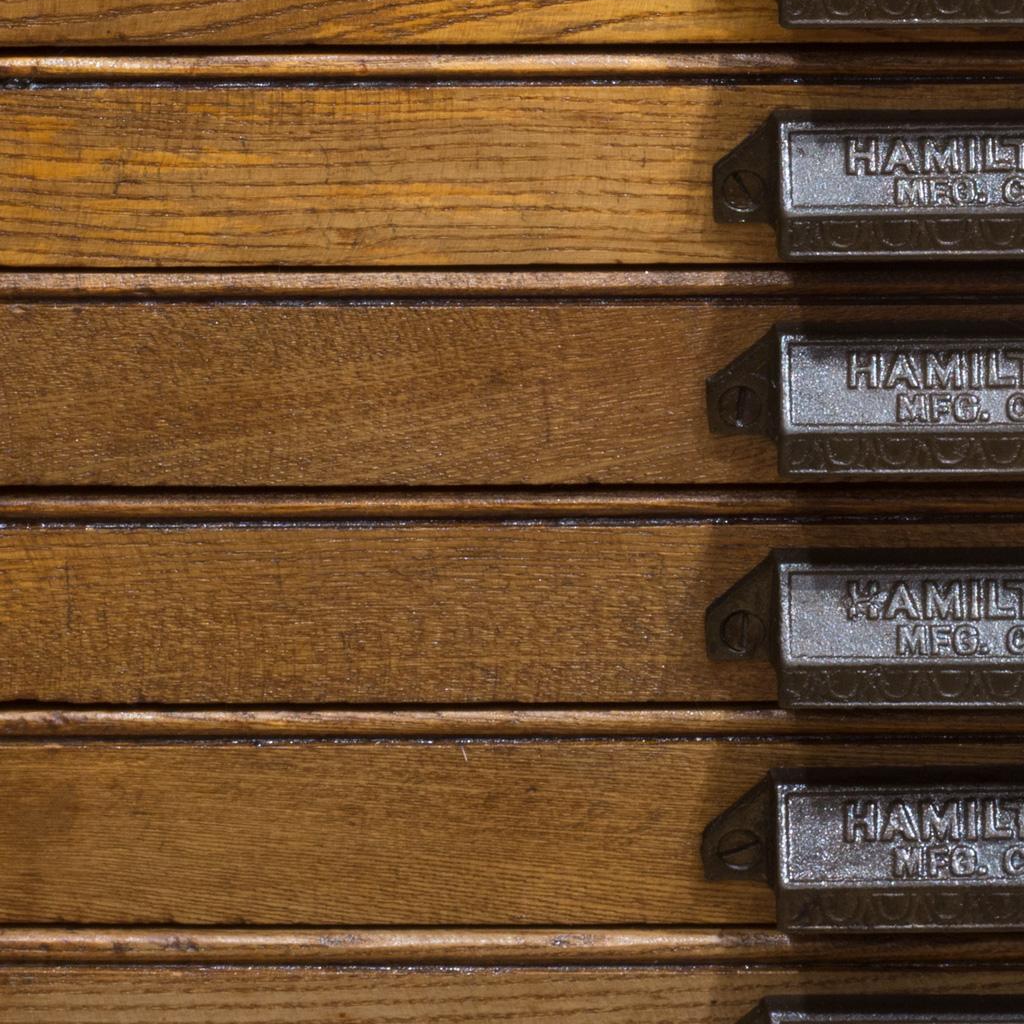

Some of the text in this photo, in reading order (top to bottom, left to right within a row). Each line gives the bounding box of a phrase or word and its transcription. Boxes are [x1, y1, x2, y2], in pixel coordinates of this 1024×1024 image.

[894, 176, 986, 206] MFG.
[896, 393, 990, 423] MFG.
[896, 625, 989, 656] MFG.
[892, 845, 986, 878] MFG.
